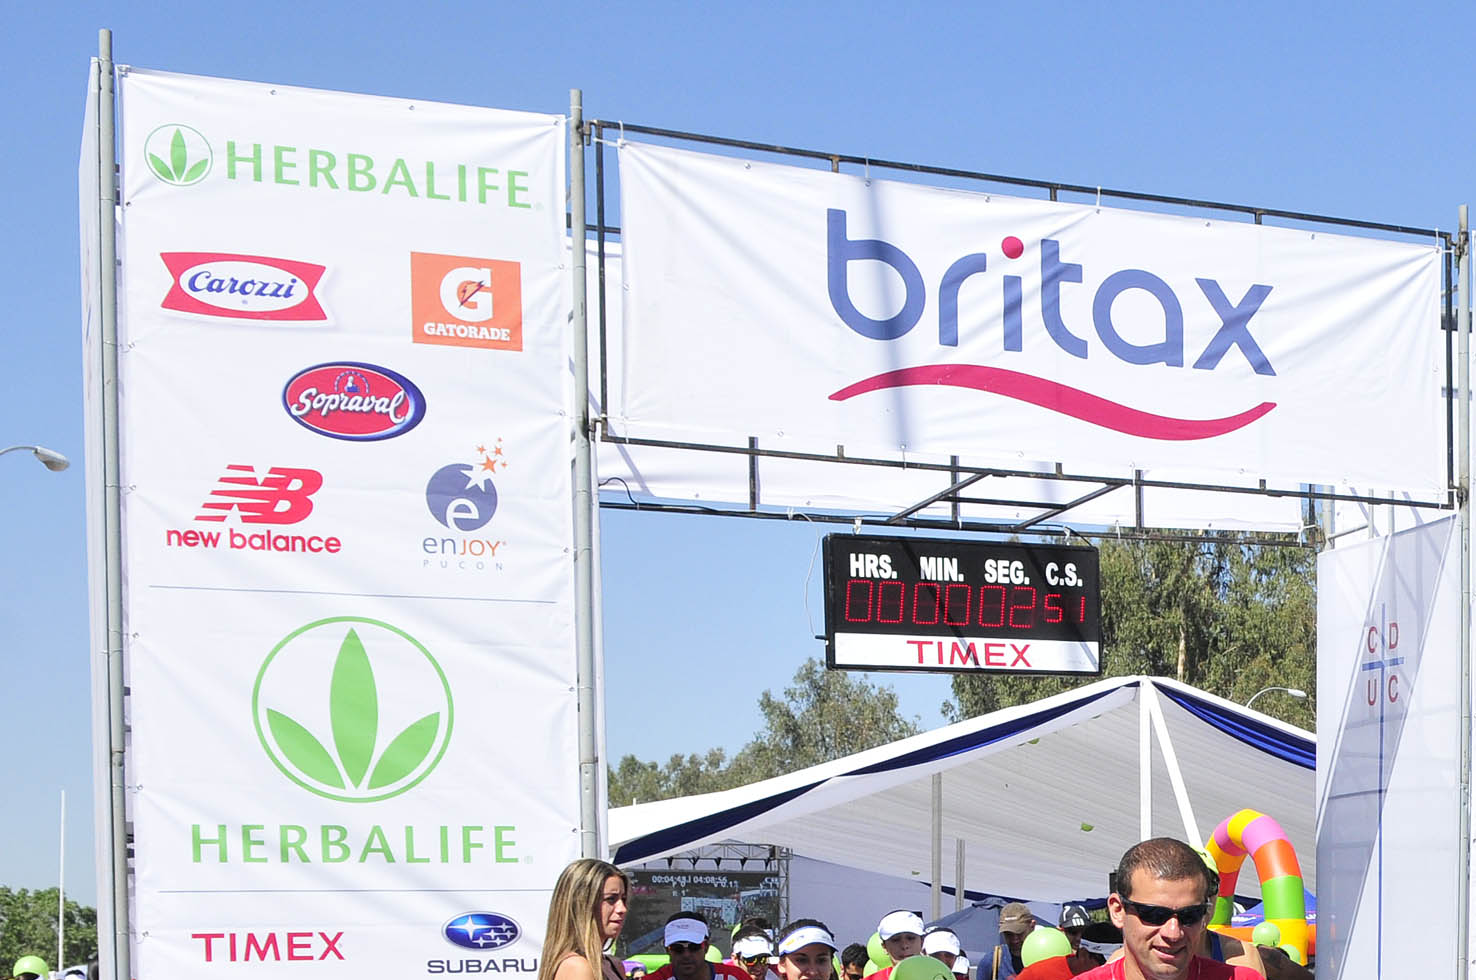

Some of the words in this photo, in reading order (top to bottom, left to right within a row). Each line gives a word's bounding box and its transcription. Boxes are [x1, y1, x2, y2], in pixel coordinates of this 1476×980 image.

[226, 141, 532, 209] HERBALIFE
[187, 269, 299, 300] Carozzi
[439, 267, 493, 320] G
[826, 208, 1277, 376] britax
[424, 321, 511, 342] GATORADE
[290, 385, 408, 424] Sopraval
[167, 528, 221, 550] new
[229, 528, 341, 554] balance
[850, 553, 898, 579] HRS.
[920, 556, 964, 583] MIN.
[984, 559, 1030, 585] SEG.
[1045, 562, 1083, 587] C.S.
[906, 640, 1032, 668] TIMEX
[191, 823, 519, 864] HERBALIFE
[192, 931, 345, 962] TIMEX
[427, 959, 538, 974] SUBARU
